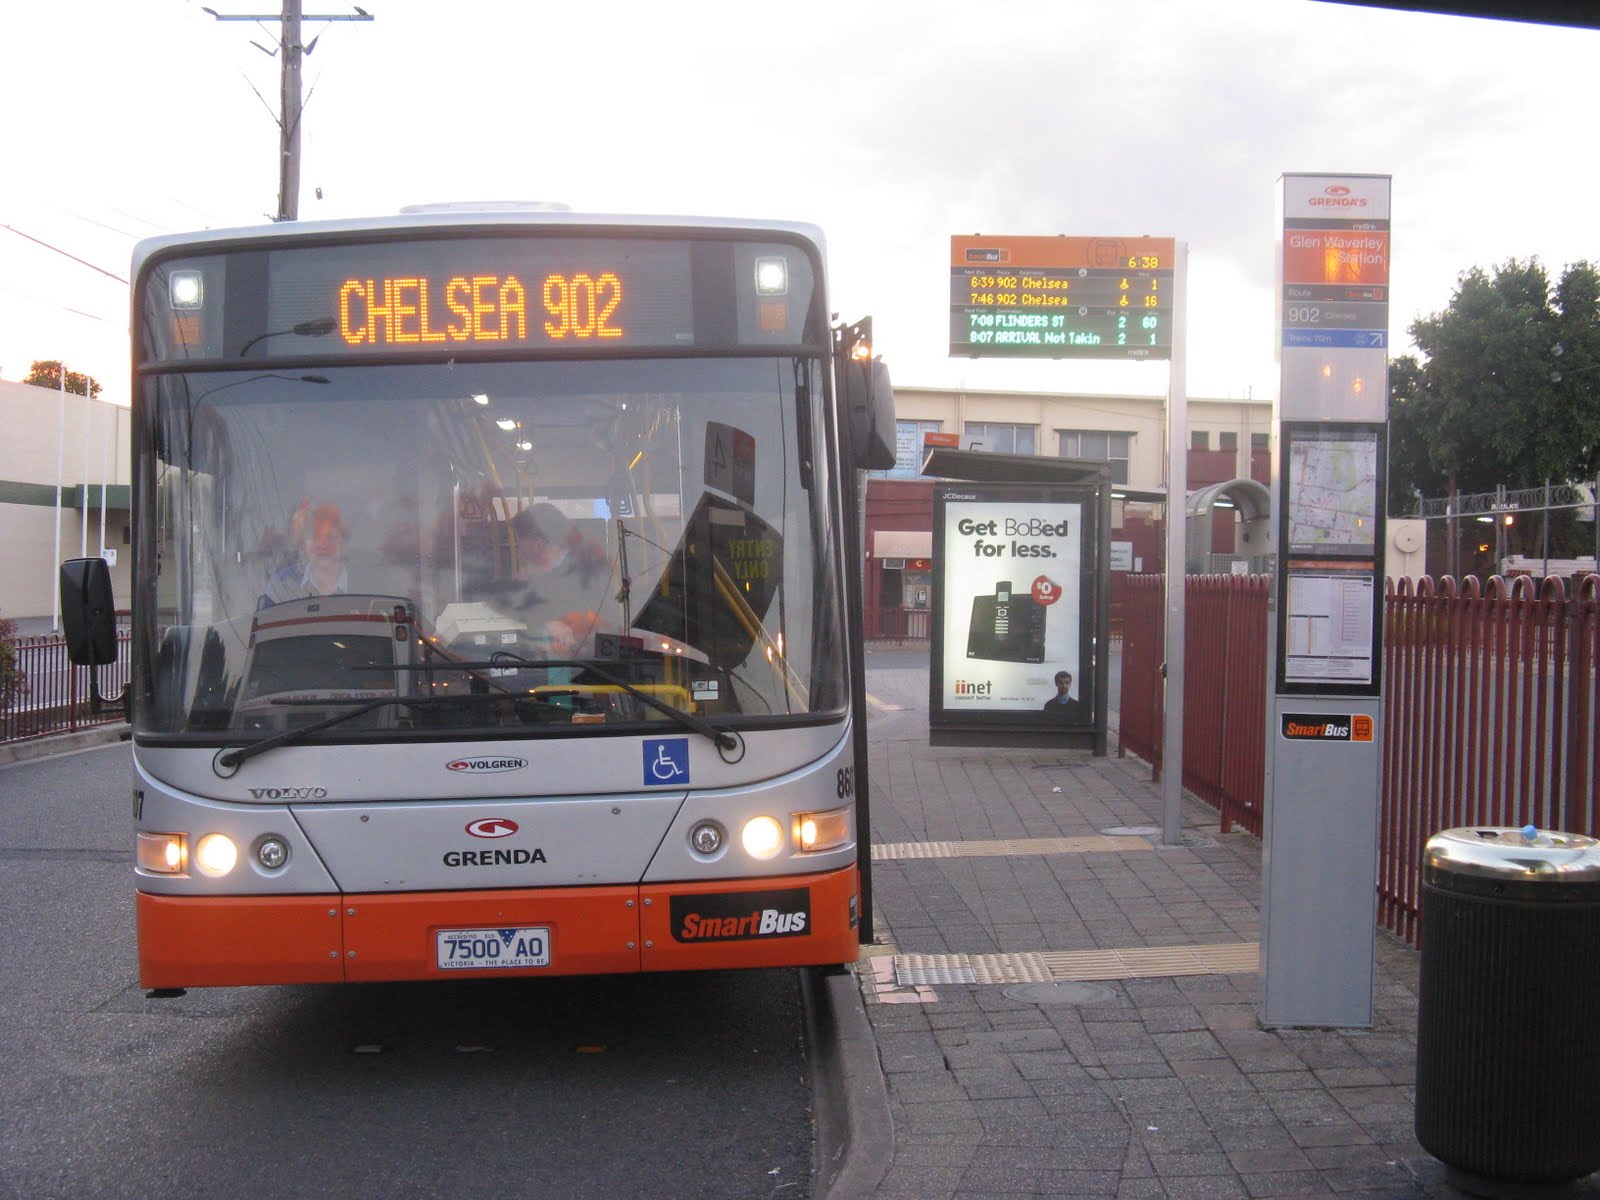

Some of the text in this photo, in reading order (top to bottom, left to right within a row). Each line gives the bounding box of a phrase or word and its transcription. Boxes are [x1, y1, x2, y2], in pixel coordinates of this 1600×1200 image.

[1308, 197, 1368, 207] GRENDA'S
[1290, 235, 1383, 251] Glen Waverley
[1128, 256, 1159, 269] 6:38
[1338, 250, 1383, 264] Station
[996, 276, 1018, 289] 902
[1022, 277, 1069, 289] Chelsea
[1151, 278, 1158, 290] 1
[996, 293, 1017, 305] 902
[1021, 293, 1068, 305] Chelsea
[1288, 288, 1312, 297] Route
[340, 273, 622, 344] CHELSEA 902
[1288, 307, 1320, 323] 902
[995, 314, 1049, 327] FLINDERS
[1051, 315, 1065, 328] ST
[1118, 316, 1127, 329] 2
[995, 331, 1041, 344] ARRIVAL
[1045, 332, 1065, 344] Not
[1069, 332, 1101, 344] Takin
[1118, 332, 1126, 345] 2
[1150, 333, 1157, 345] 1
[942, 492, 977, 500] JCDecaux
[957, 518, 1069, 537] Get BoBed
[973, 540, 1058, 558] for less.
[1036, 581, 1053, 595] $0
[955, 680, 993, 695] iinet
[1286, 722, 1349, 736] SmartBus
[469, 759, 523, 769] VOLGREN
[248, 786, 328, 799] VOLVO
[443, 848, 547, 868] GRENDA
[682, 909, 807, 939] SmartBus
[443, 939, 500, 959] 7500
